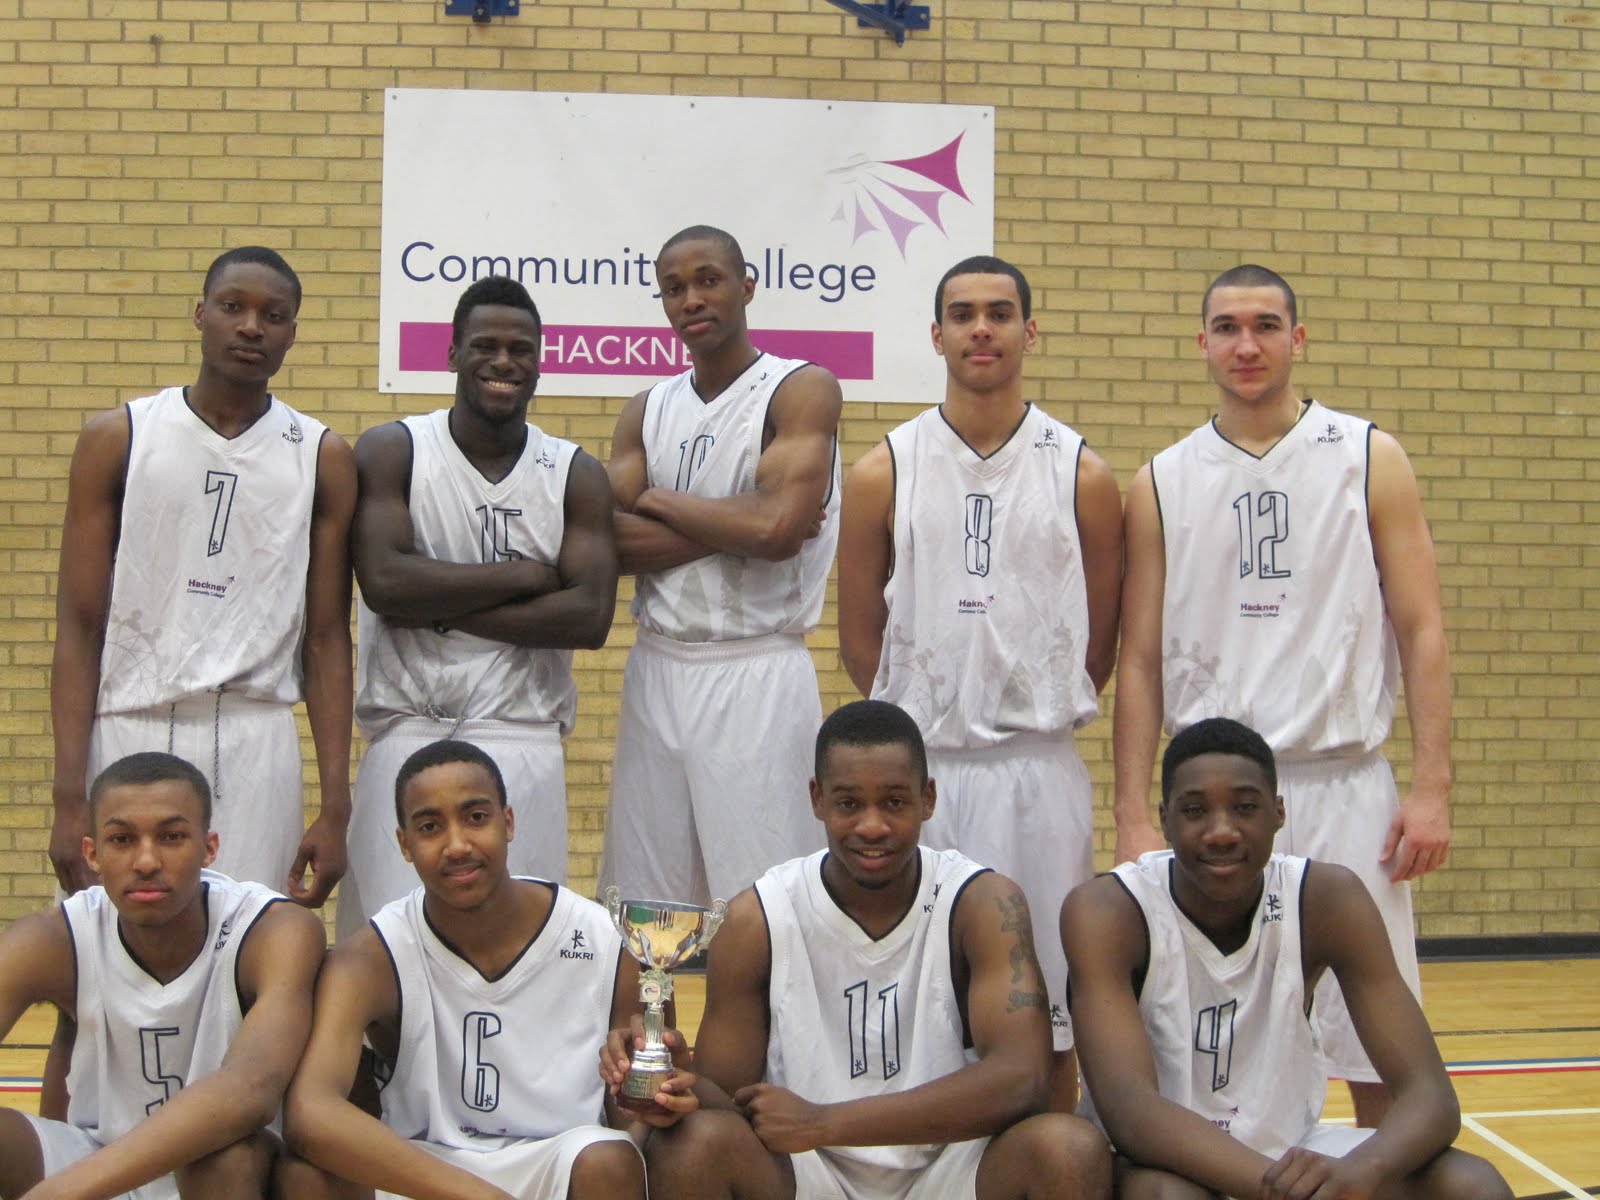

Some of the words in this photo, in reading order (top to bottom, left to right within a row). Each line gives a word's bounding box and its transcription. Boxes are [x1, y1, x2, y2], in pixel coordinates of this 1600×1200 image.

[745, 248, 876, 303] ollege
[541, 335, 694, 366] HACKNE
[204, 470, 237, 557] 7
[965, 494, 992, 578] 8
[1233, 490, 1291, 579] 12
[188, 579, 228, 593] Hackney
[1240, 603, 1280, 612] Hackney
[560, 949, 594, 961] KUKRI
[139, 1027, 183, 1117] 5
[460, 1011, 502, 1113] 6
[844, 980, 900, 1081] 11
